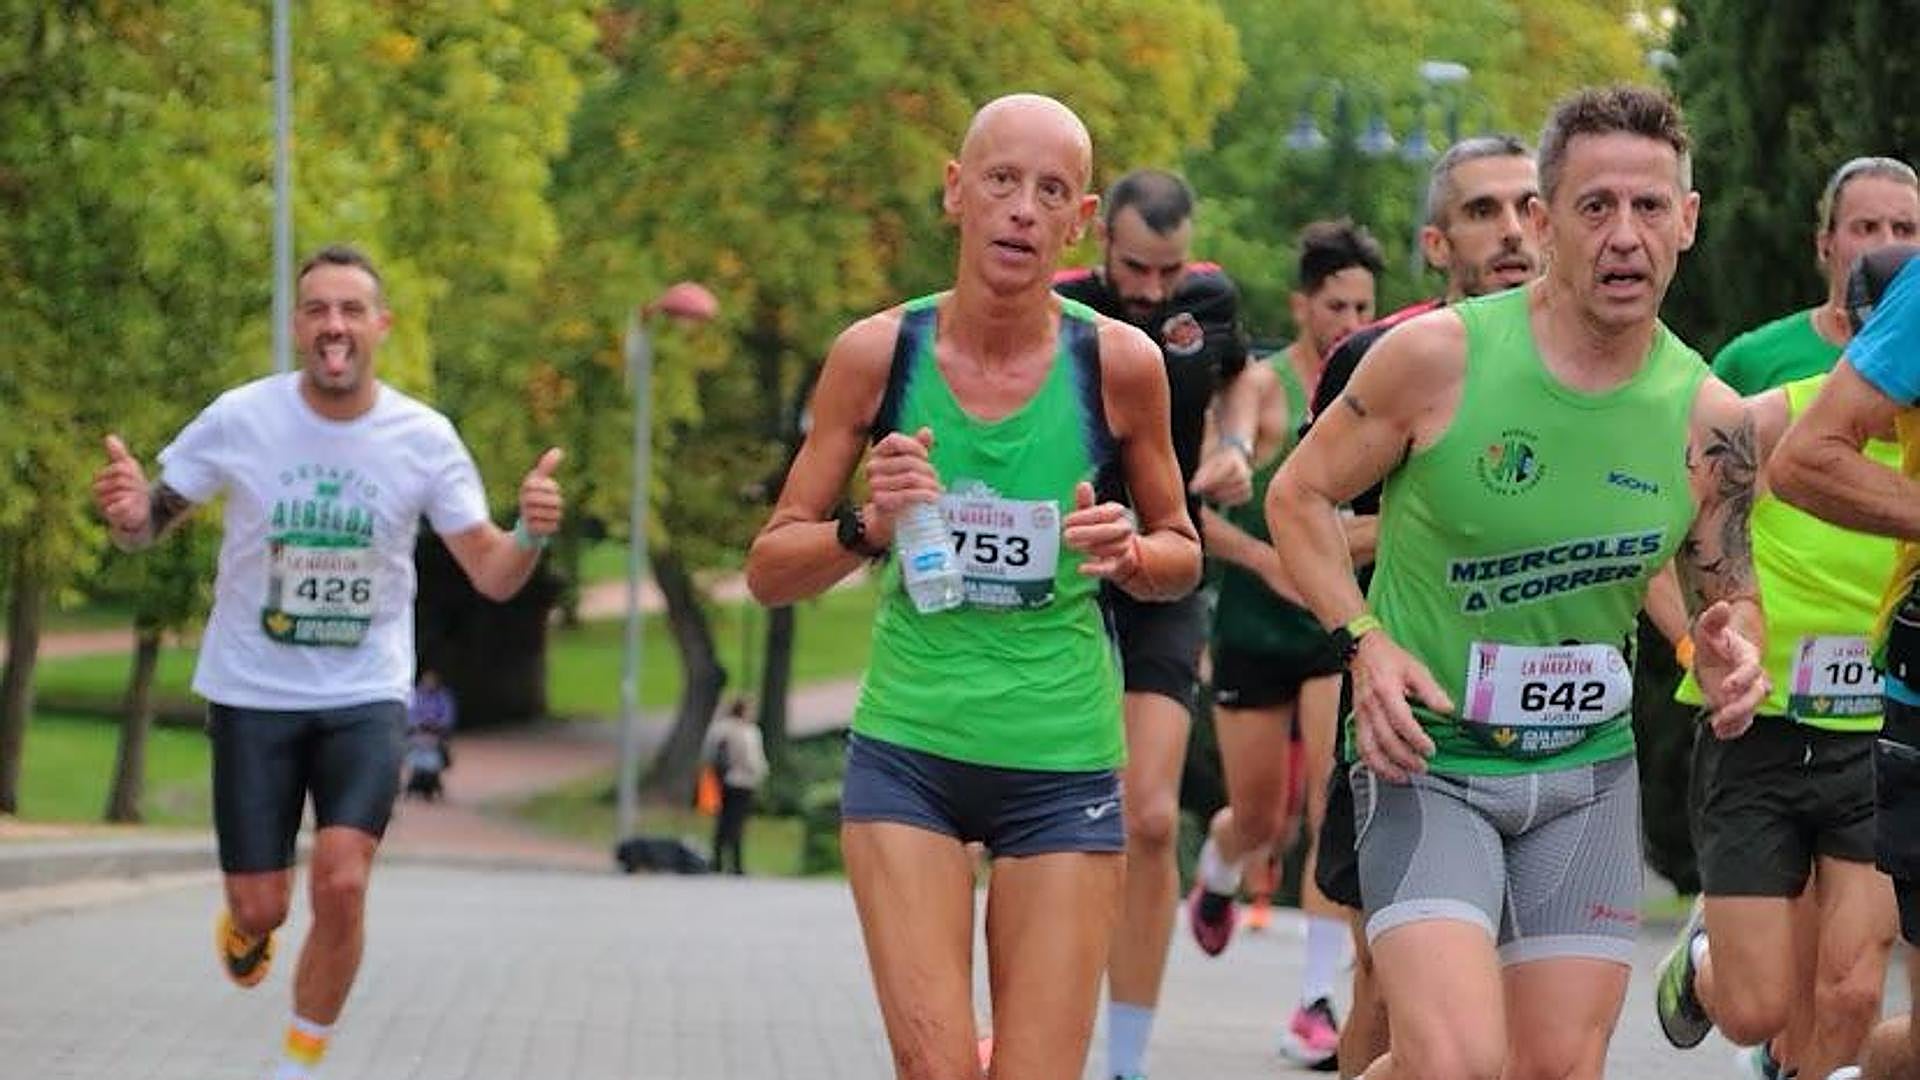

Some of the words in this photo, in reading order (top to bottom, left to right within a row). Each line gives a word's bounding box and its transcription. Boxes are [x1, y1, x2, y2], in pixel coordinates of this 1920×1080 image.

[951, 530, 1030, 567] 753
[1451, 533, 1662, 583] MIERCOLES
[297, 577, 372, 605] 426
[1464, 591, 1488, 612] A
[1499, 563, 1643, 605] CORRER
[1520, 681, 1607, 712] 642
